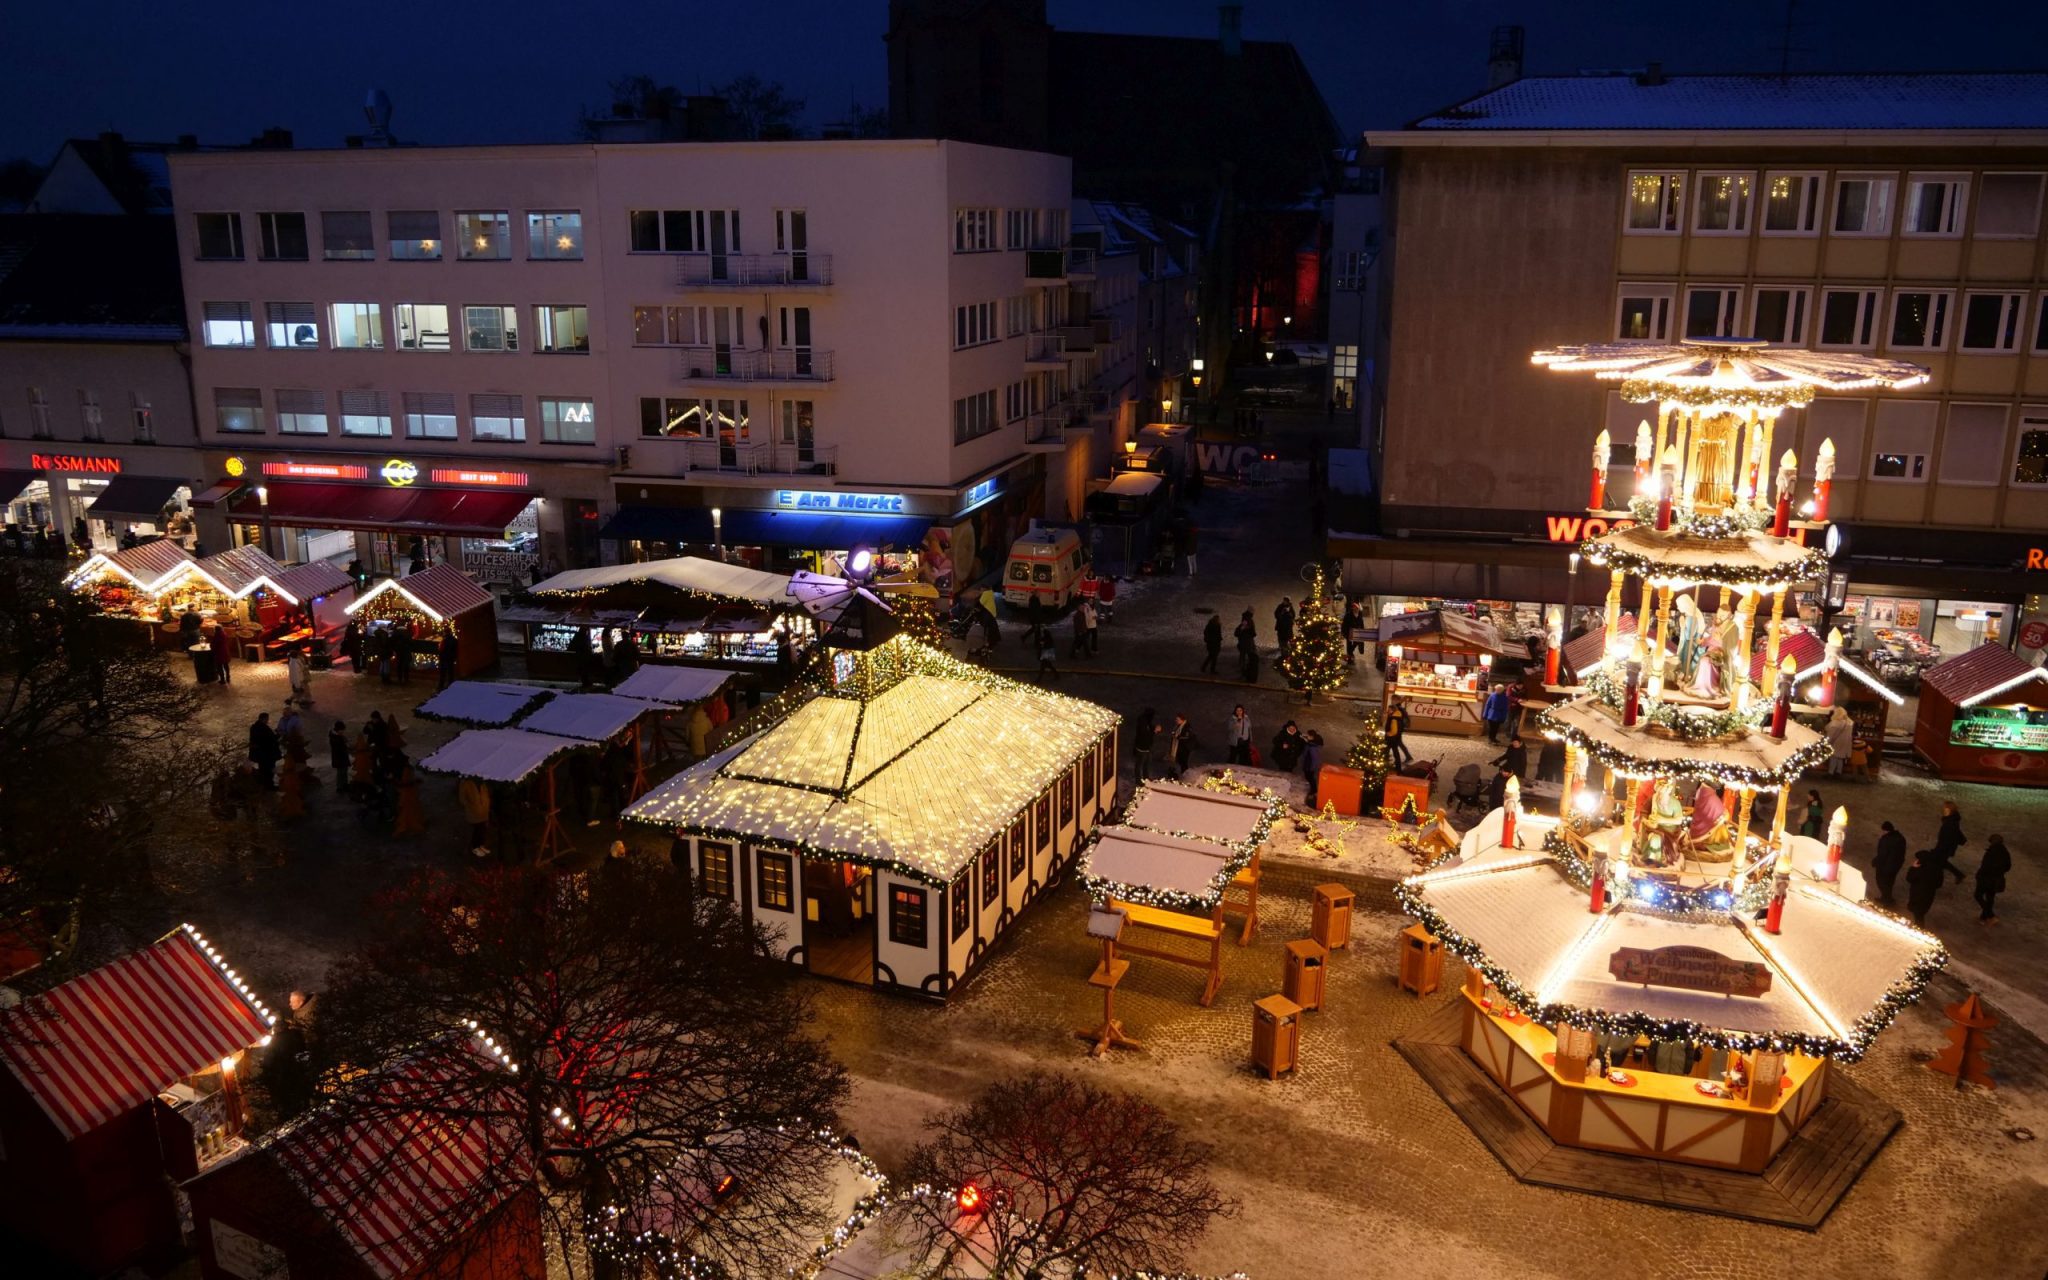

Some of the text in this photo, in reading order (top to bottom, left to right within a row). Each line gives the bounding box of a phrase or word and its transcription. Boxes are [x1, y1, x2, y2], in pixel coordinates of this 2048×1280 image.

[32, 454, 120, 472] ROSSMANN
[798, 492, 831, 507] Am
[837, 494, 903, 510] Markt
[466, 554, 505, 565] JUICES
[1414, 703, 1453, 718] Crêpes
